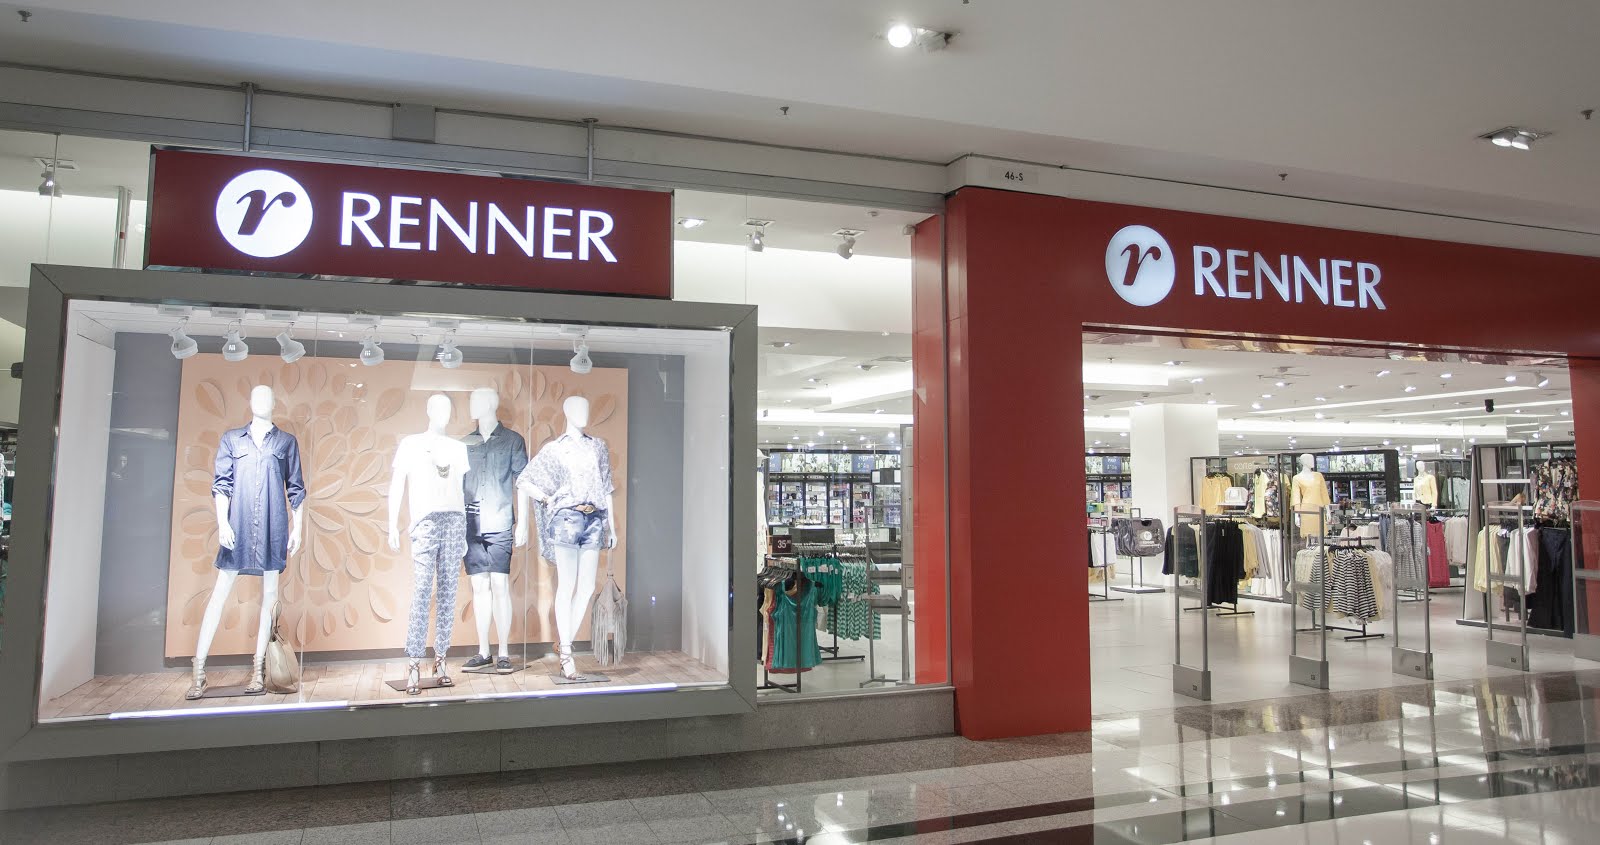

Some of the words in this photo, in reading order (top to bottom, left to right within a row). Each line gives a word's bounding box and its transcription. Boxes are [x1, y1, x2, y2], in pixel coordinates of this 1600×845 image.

[1004, 170, 1024, 182] 46-S
[340, 191, 618, 263] RENNER
[1192, 245, 1387, 310] RENNER
